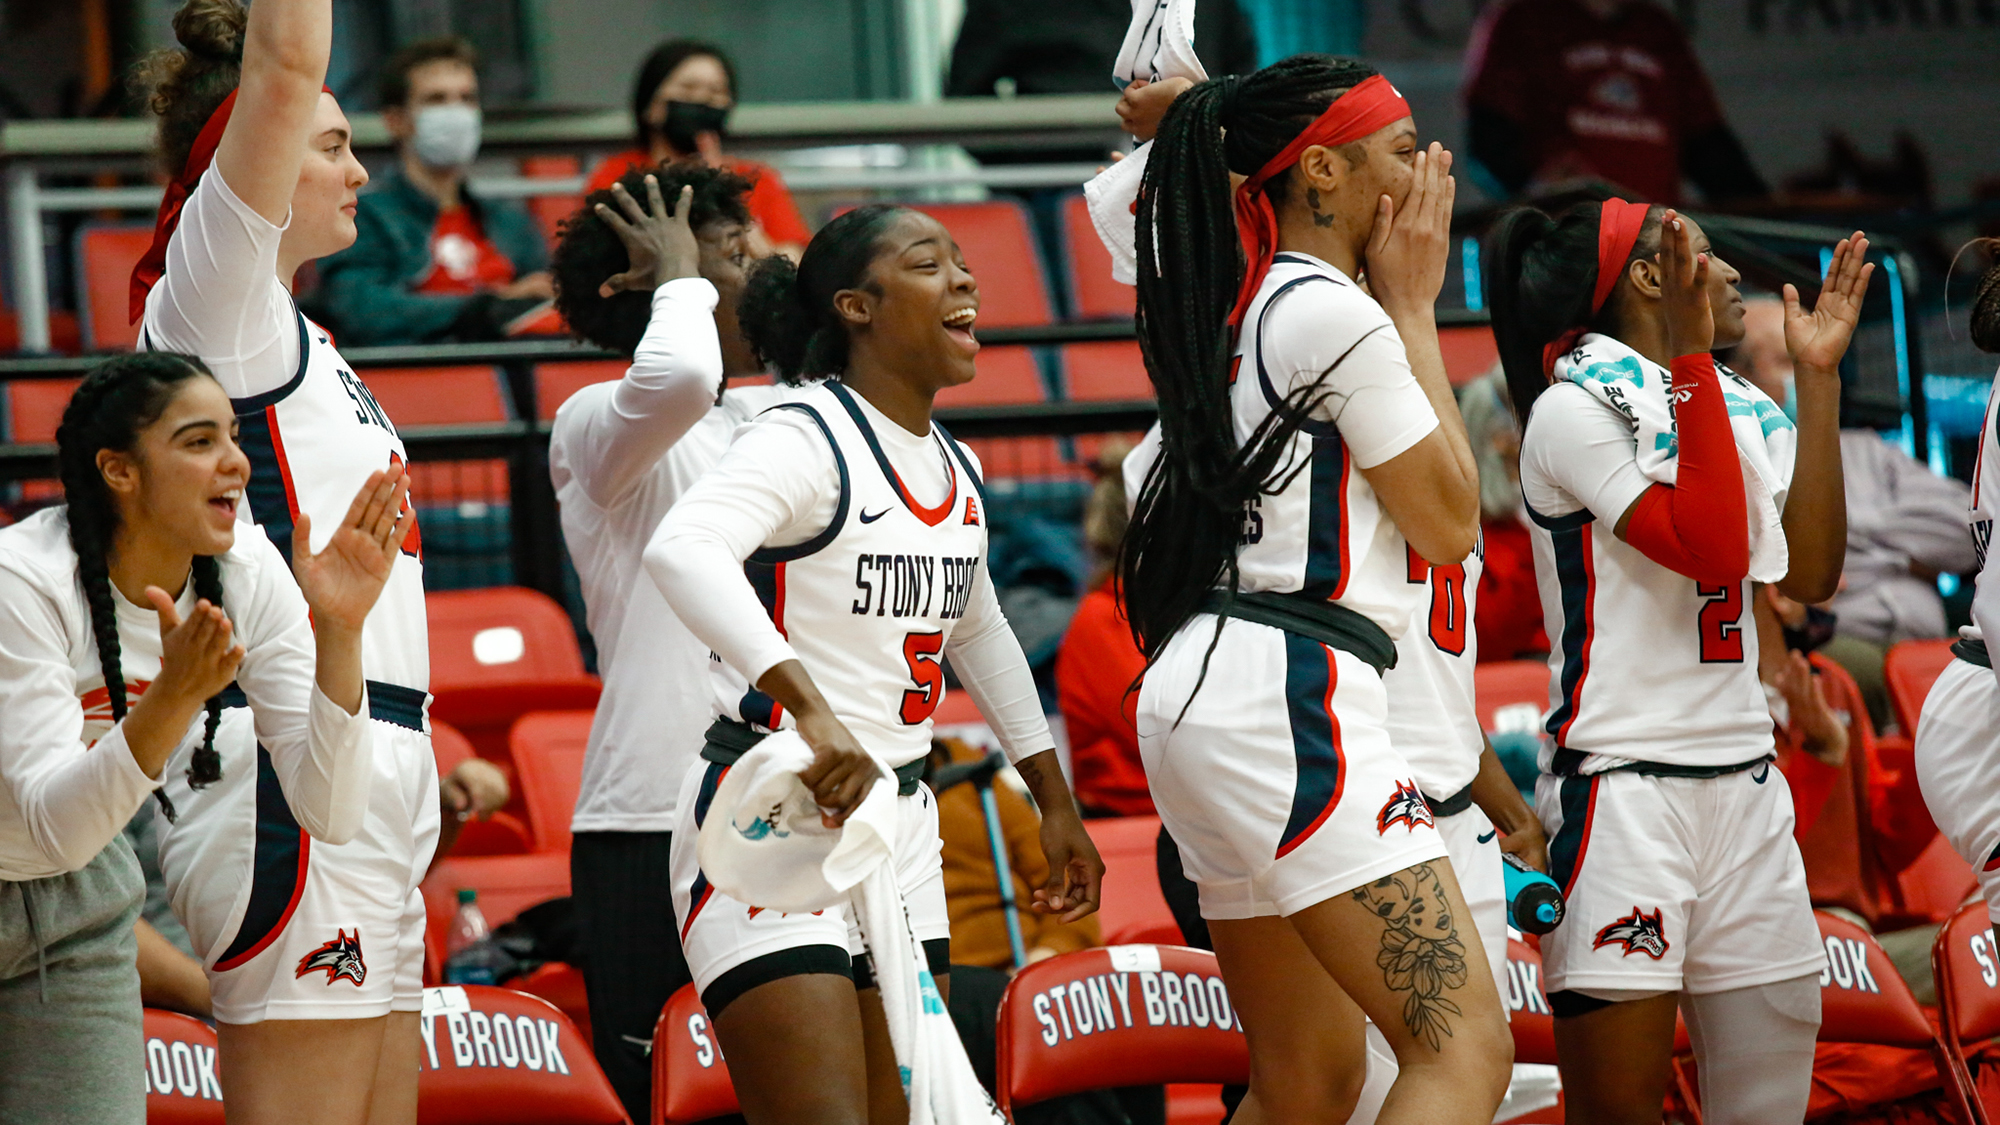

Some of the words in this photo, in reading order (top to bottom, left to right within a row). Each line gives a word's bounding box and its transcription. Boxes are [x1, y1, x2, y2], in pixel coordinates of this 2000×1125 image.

[851, 553, 934, 618] STONY
[1696, 578, 1744, 663] 2
[899, 629, 943, 726] 5
[446, 1010, 571, 1076] BROOK
[1032, 972, 1134, 1048] STONY
[1139, 970, 1244, 1033] BROO
[145, 1037, 223, 1102] OOK
